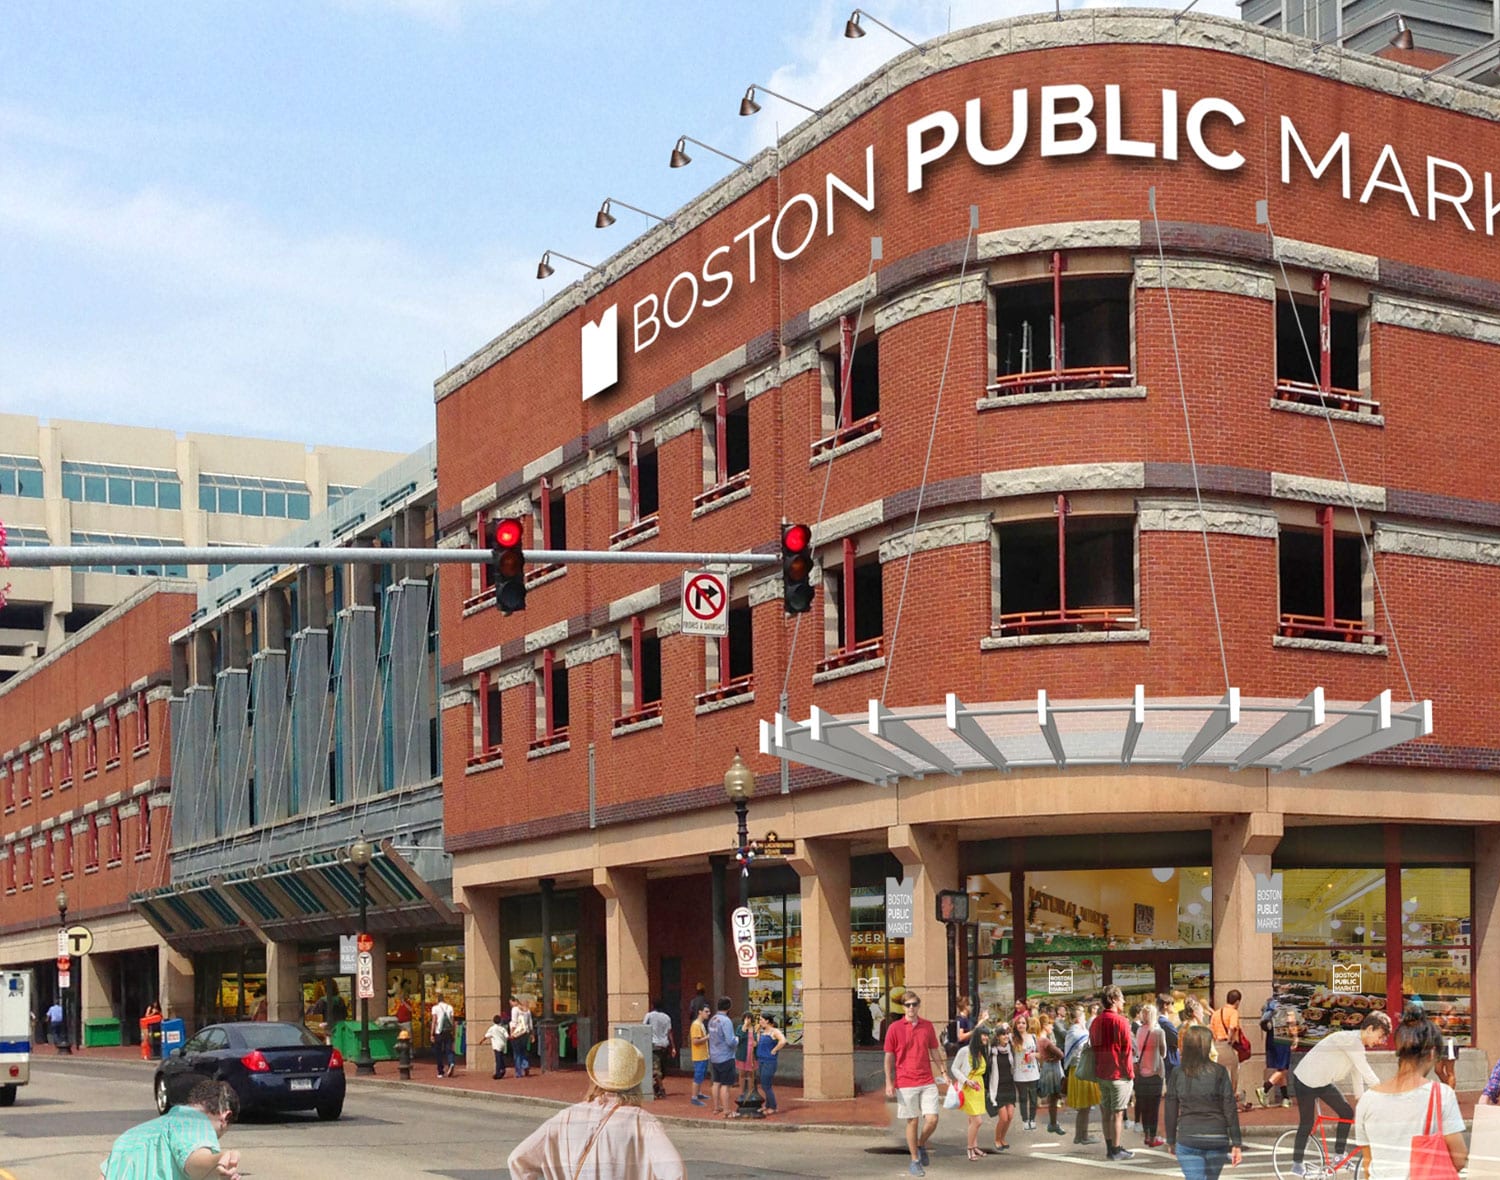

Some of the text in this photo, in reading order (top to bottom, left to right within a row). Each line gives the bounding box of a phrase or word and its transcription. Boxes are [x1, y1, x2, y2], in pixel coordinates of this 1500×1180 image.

[634, 144, 875, 353] BOSTON
[907, 84, 1246, 193] PUBLIC
[887, 894, 912, 905] BOSTON
[1257, 889, 1282, 900] BOSTON
[888, 908, 909, 919] PUBLIC
[1257, 904, 1279, 914] PUBLIC
[888, 922, 912, 933] MARKET
[1257, 917, 1281, 928] MARKET
[69, 934, 87, 951] T
